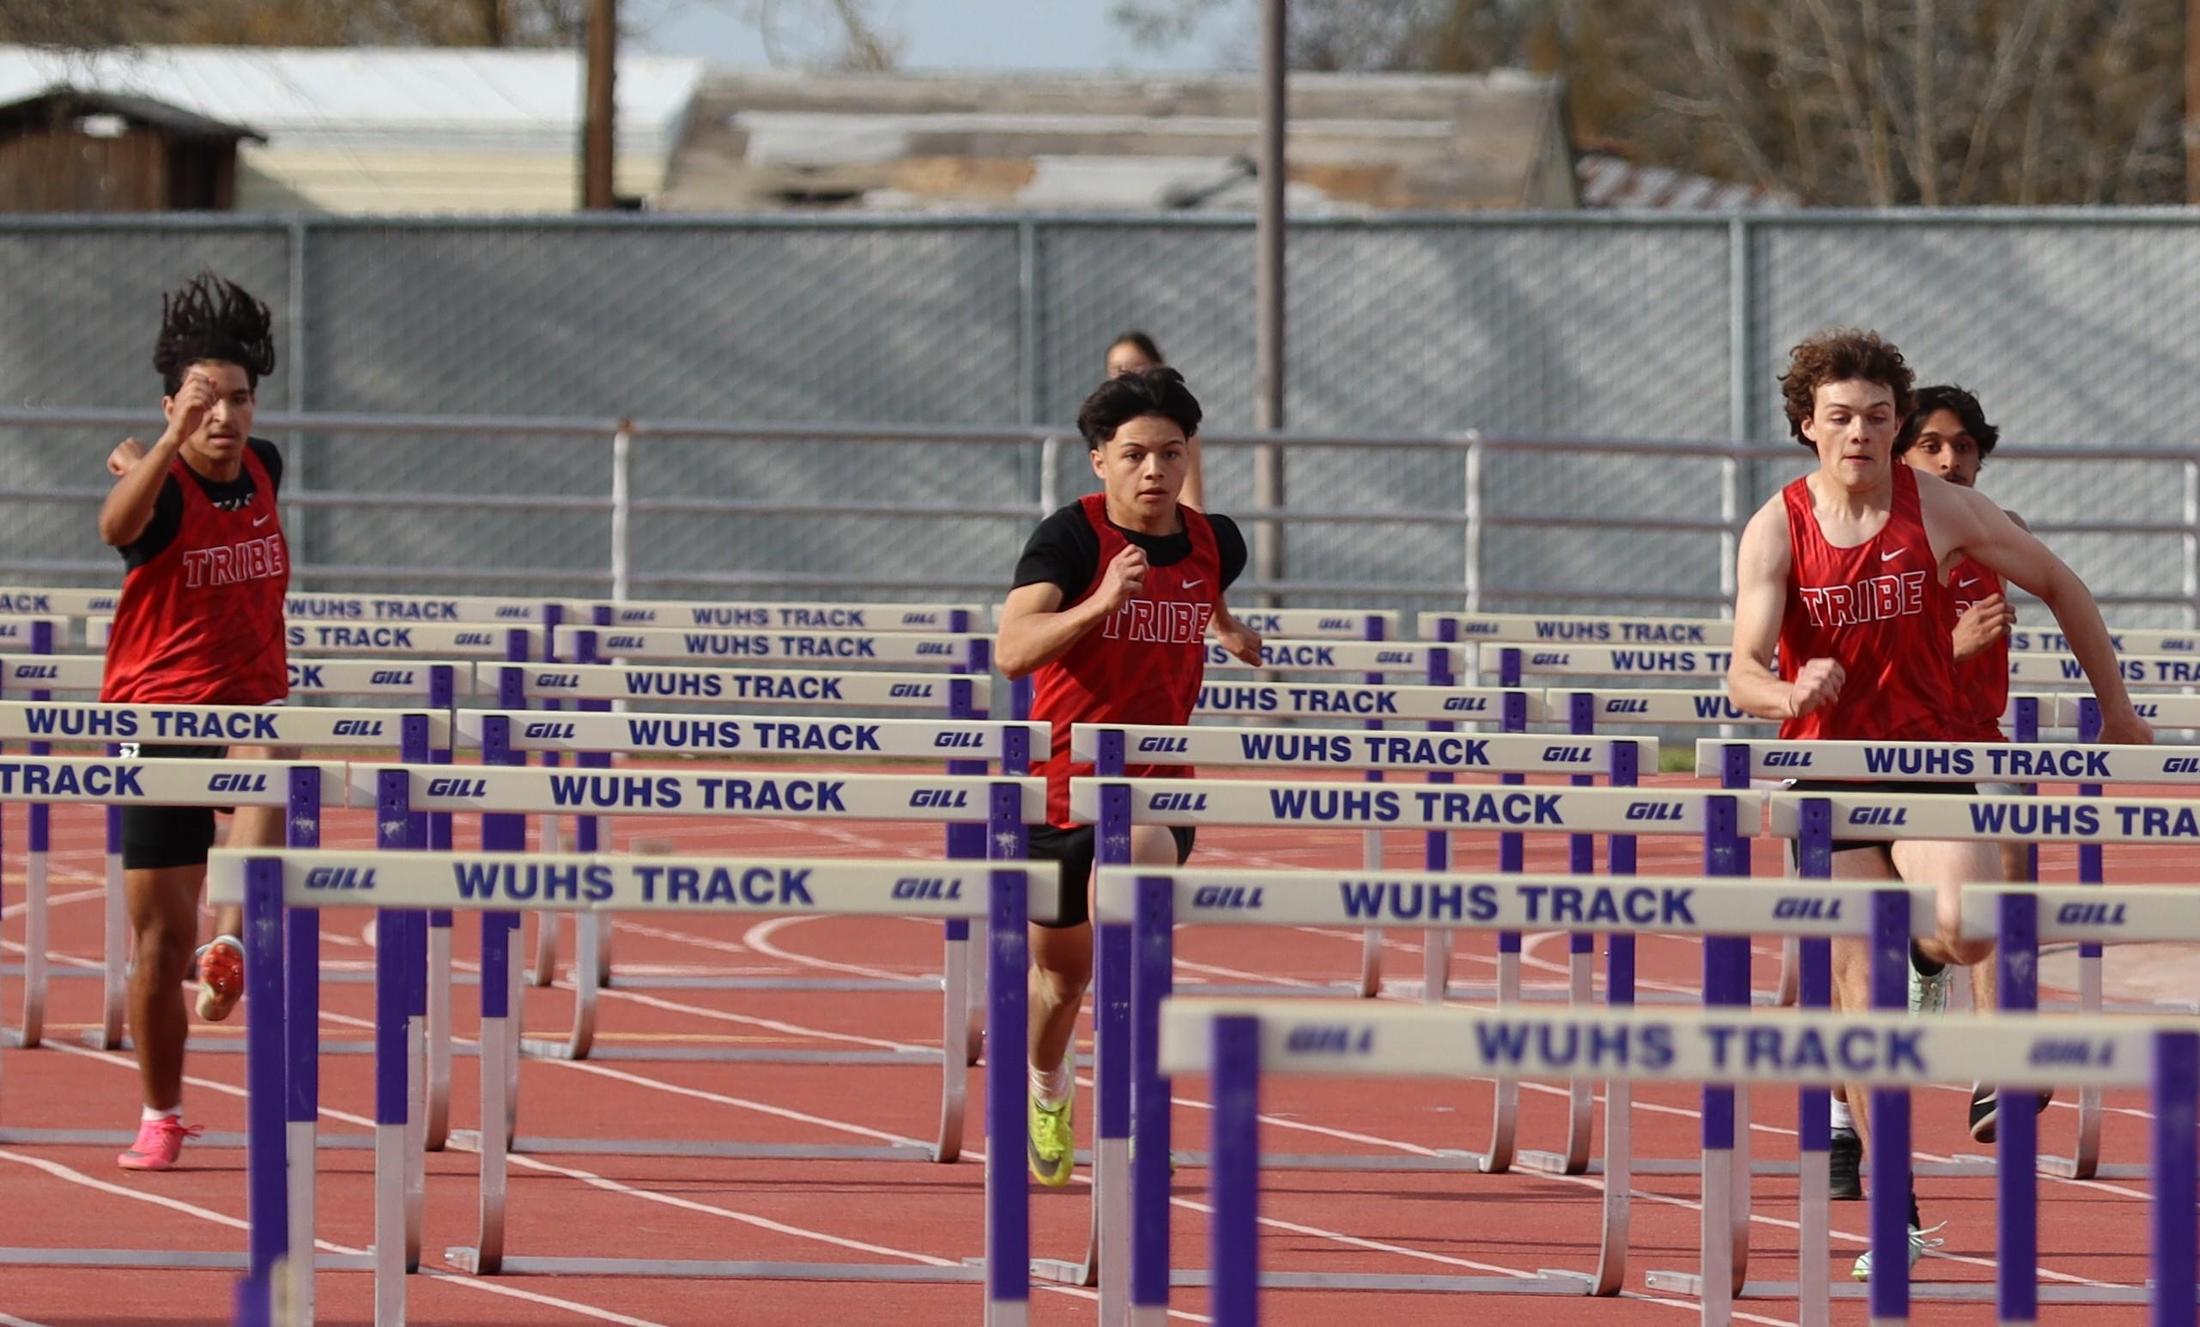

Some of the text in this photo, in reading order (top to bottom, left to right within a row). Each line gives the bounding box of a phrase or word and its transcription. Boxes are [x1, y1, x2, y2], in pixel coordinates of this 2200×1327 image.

[183, 534, 283, 588] TRIBE
[0, 594, 49, 612] ACK
[288, 600, 528, 619] WUHS TRACK GILL
[1799, 571, 1926, 627] TRIBE
[621, 609, 934, 626] GILL WUHS TRACK GILL
[1103, 599, 1214, 643] TRIBE
[1319, 620, 1351, 629] GILL
[317, 627, 411, 647] TRACK
[455, 634, 491, 645] GILL
[1536, 622, 1610, 640] WUHS
[1621, 624, 1703, 643] TRACK
[607, 635, 952, 657] GILL WUHS TRACK GILL
[1259, 646, 1413, 665] RACK GILL
[1532, 654, 1568, 665] GILL
[1612, 651, 1695, 671] WUHS
[2154, 661, 2200, 681] TRA
[15, 666, 412, 684] GILL GILL
[536, 673, 931, 699] GILL WUHS TRACK GILL
[1289, 689, 1397, 713] TRACK
[1444, 698, 1486, 710] GILL
[1606, 696, 1754, 718] GILL WU
[25, 708, 382, 739] WUHS TRACK GILL
[525, 720, 983, 750] GILL WUHS TRACK GILL
[1138, 734, 1591, 765] GILL WUHS TRACK GILL
[1763, 748, 2200, 776] GILL WUHS TRACK GIL
[0, 763, 266, 796] TRACK GILL
[427, 776, 967, 811] GILL WUHS TRACK GILL
[1149, 789, 1683, 824] GILL WUHS TRACK GILL
[1848, 804, 2200, 837] GILL WUHS TRA
[304, 863, 960, 905] GILL WUHS TRACK GILL
[1193, 883, 1840, 924] GILL WUHS TRACK GILL
[2056, 904, 2124, 924] GILL
[1477, 1024, 1675, 1069] WUHS
[1704, 1026, 1925, 1074] TRACK
